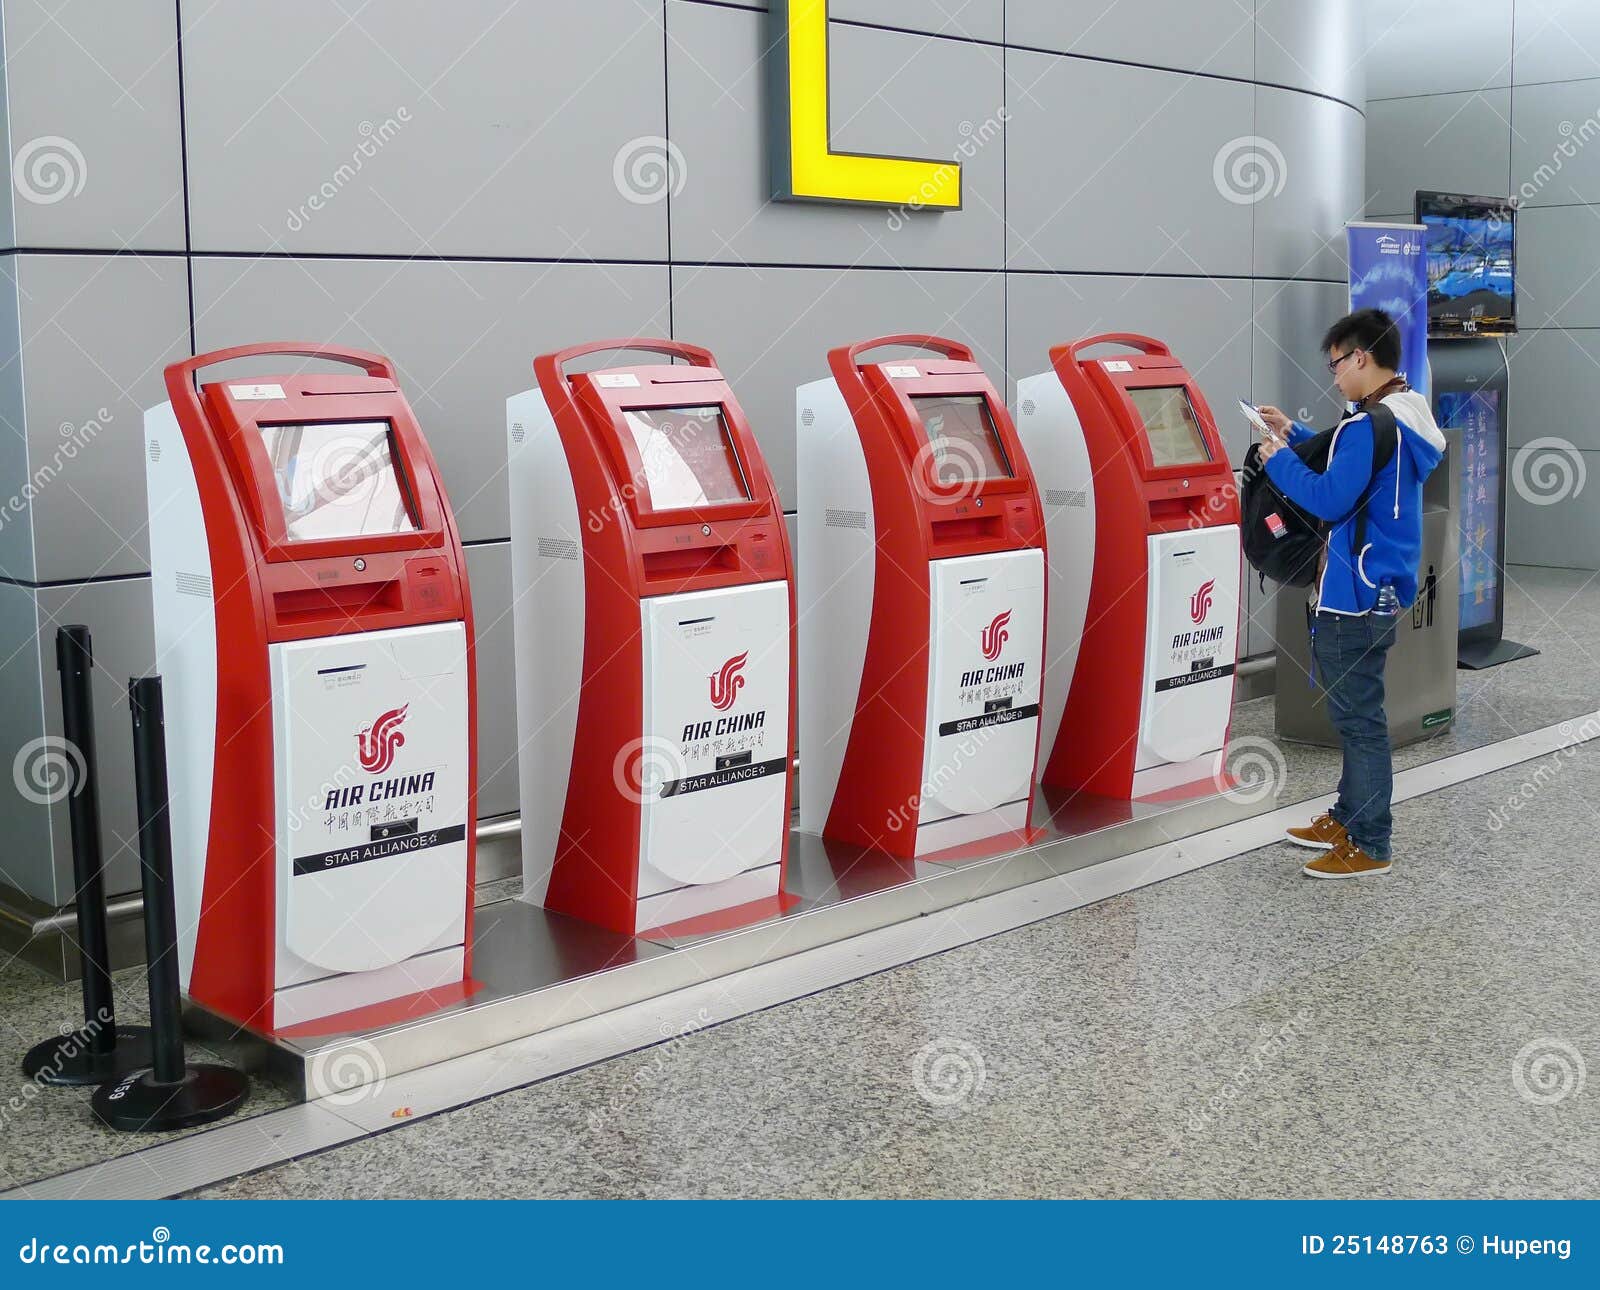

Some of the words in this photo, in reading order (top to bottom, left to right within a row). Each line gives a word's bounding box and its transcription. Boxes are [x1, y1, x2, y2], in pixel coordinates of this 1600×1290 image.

[788, 0, 960, 207] L
[1462, 320, 1478, 332] TCL
[1172, 632, 1191, 649] AIR
[1192, 626, 1223, 644] CHINA
[960, 669, 984, 688] AIR
[986, 662, 1025, 683] CHINA
[1169, 676, 1187, 687] STAR
[1187, 669, 1217, 684] ALLIANCE
[682, 721, 712, 742] AIR
[715, 710, 766, 736] CHINA
[956, 720, 978, 732] STAR
[979, 711, 1017, 727] ALLIANCE
[325, 785, 364, 811] AIR
[368, 771, 435, 802] CHINA
[680, 778, 707, 792] STAR
[709, 767, 759, 786] ALLIANCE
[324, 850, 360, 867] STAR
[363, 834, 428, 858] ALLIANCE
